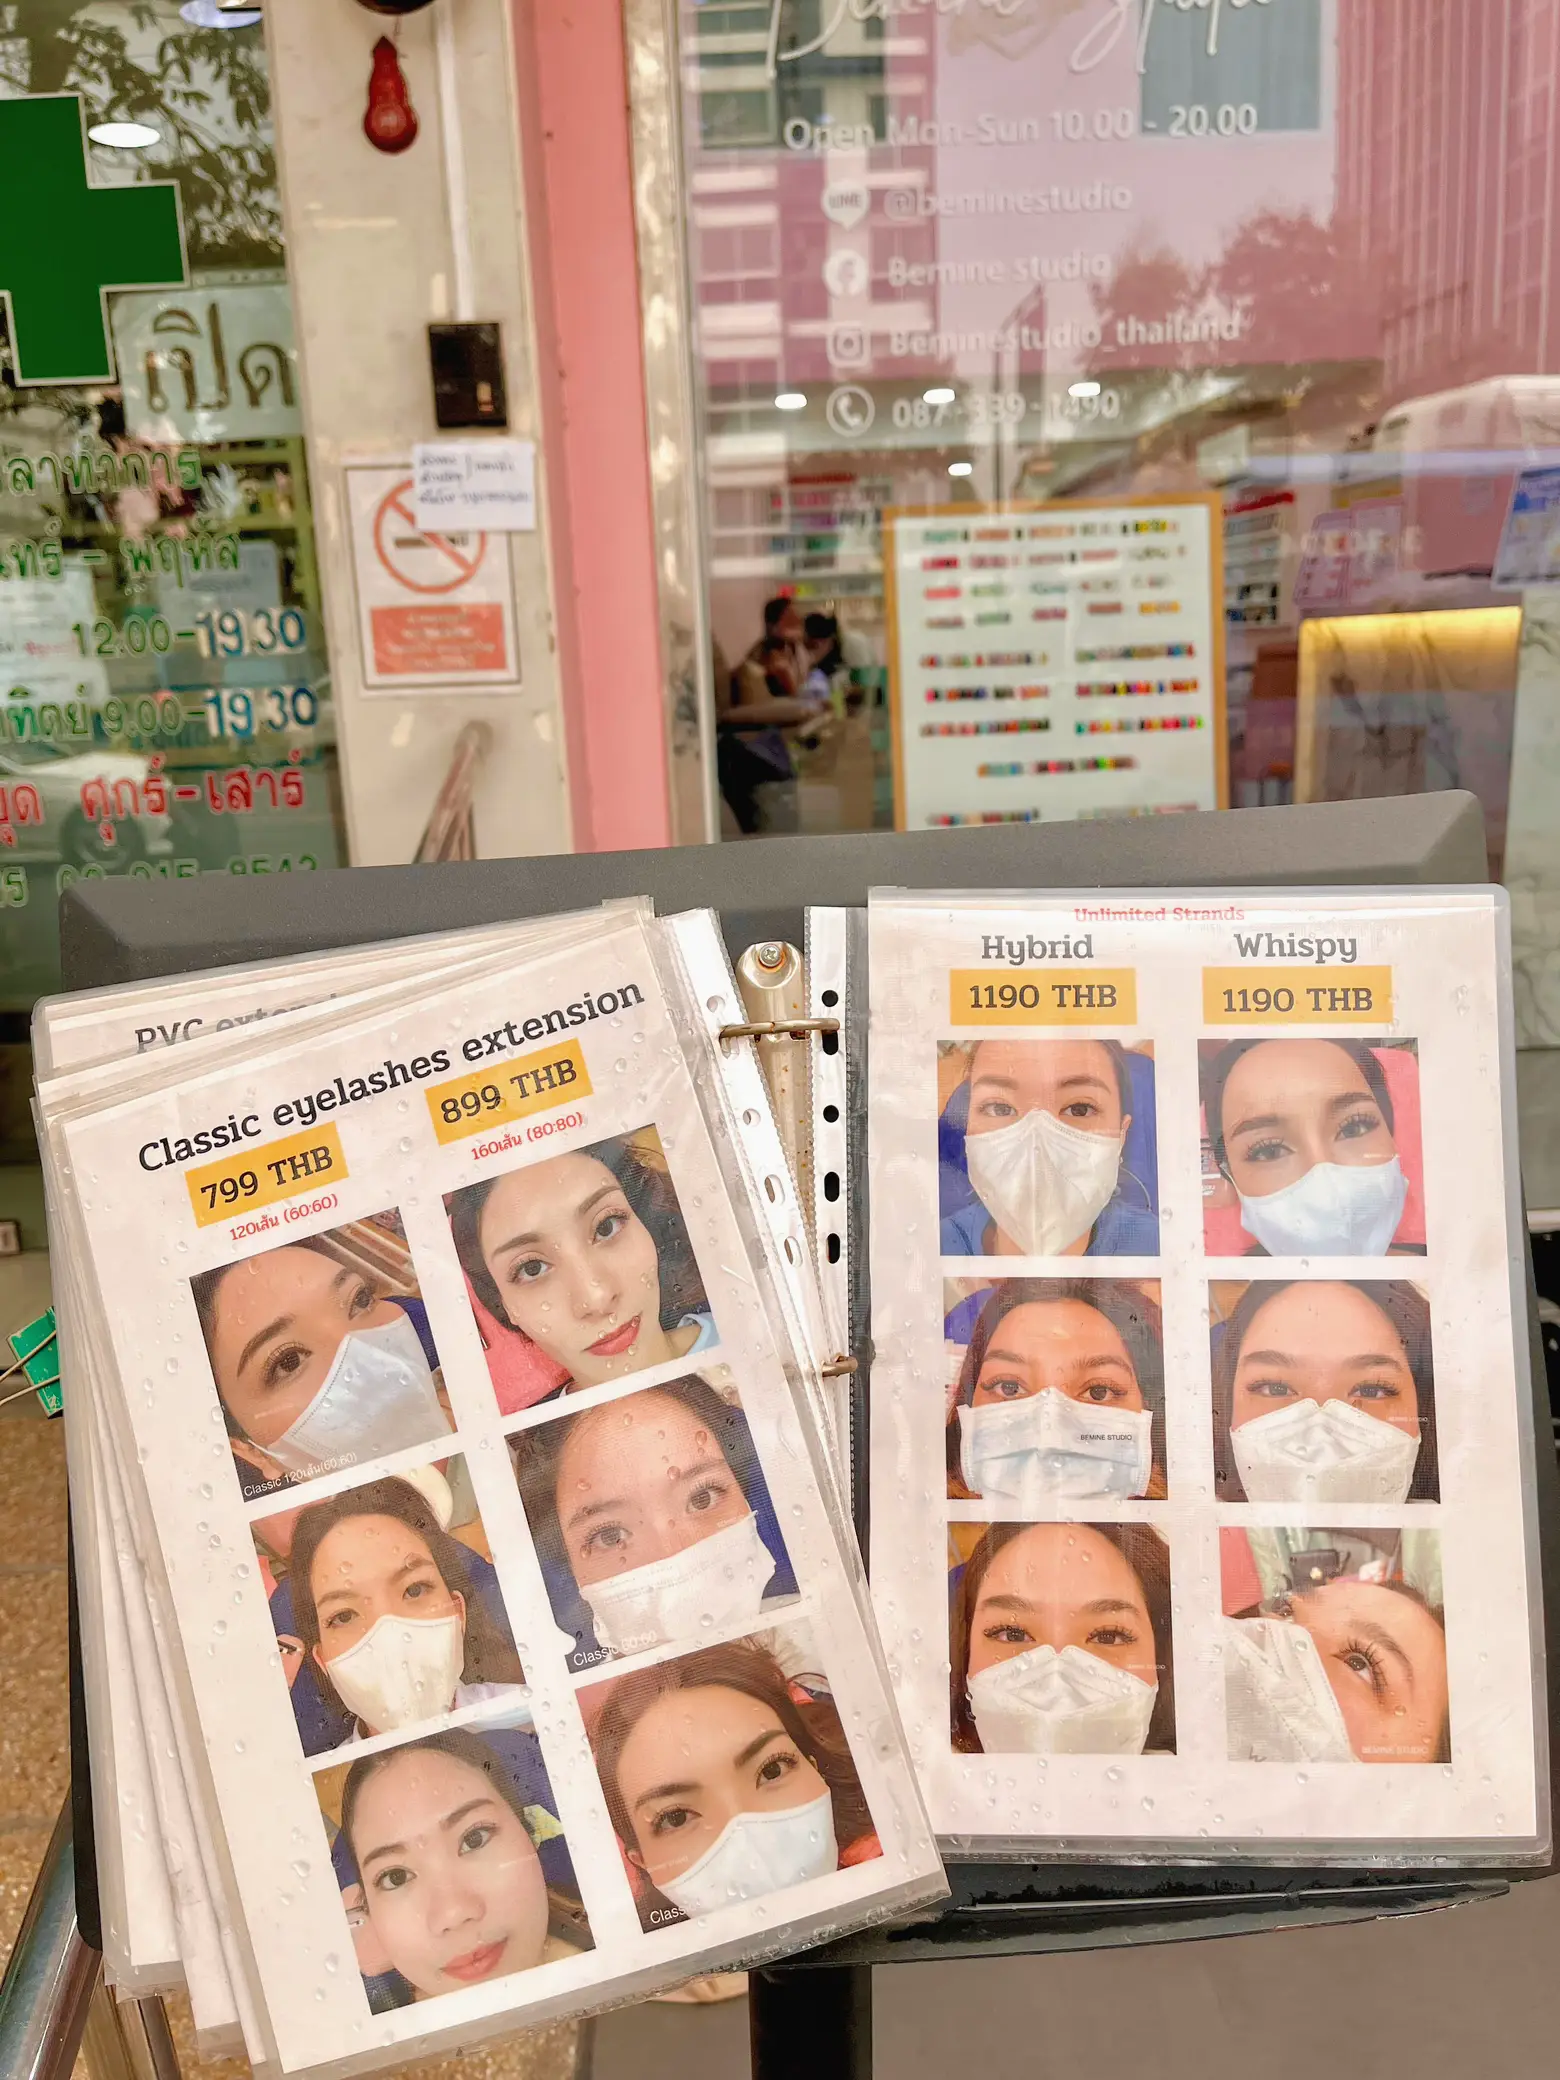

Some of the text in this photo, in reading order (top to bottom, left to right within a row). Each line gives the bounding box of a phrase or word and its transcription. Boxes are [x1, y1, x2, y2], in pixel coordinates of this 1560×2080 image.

[784, 117, 876, 154] Open
[889, 113, 1039, 146] Mon-Sun
[1052, 108, 1135, 142] 10.00
[1167, 103, 1259, 138] 20.00
[884, 183, 1134, 223] @beminestudio
[888, 250, 1113, 288] Bemine studio
[144, 301, 296, 413] เปิด
[1073, 906, 1246, 922] Unlimited Strands
[981, 933, 1095, 966] Hybrid
[1234, 932, 1359, 963] Whispy
[969, 983, 1118, 1009] 1190 THB
[1222, 987, 1373, 1013] 1190 THB
[134, 1018, 203, 1054] PVC
[138, 982, 645, 1172] Classic eyelashes extension
[440, 1057, 578, 1124] 899 THB
[470, 1111, 584, 1161] 160เส้น (80:80)
[200, 1144, 335, 1210] 799 THB
[229, 1192, 339, 1241] 120เส้น (60:60)
[243, 1477, 282, 1497] Classic
[573, 1645, 620, 1666] Classic
